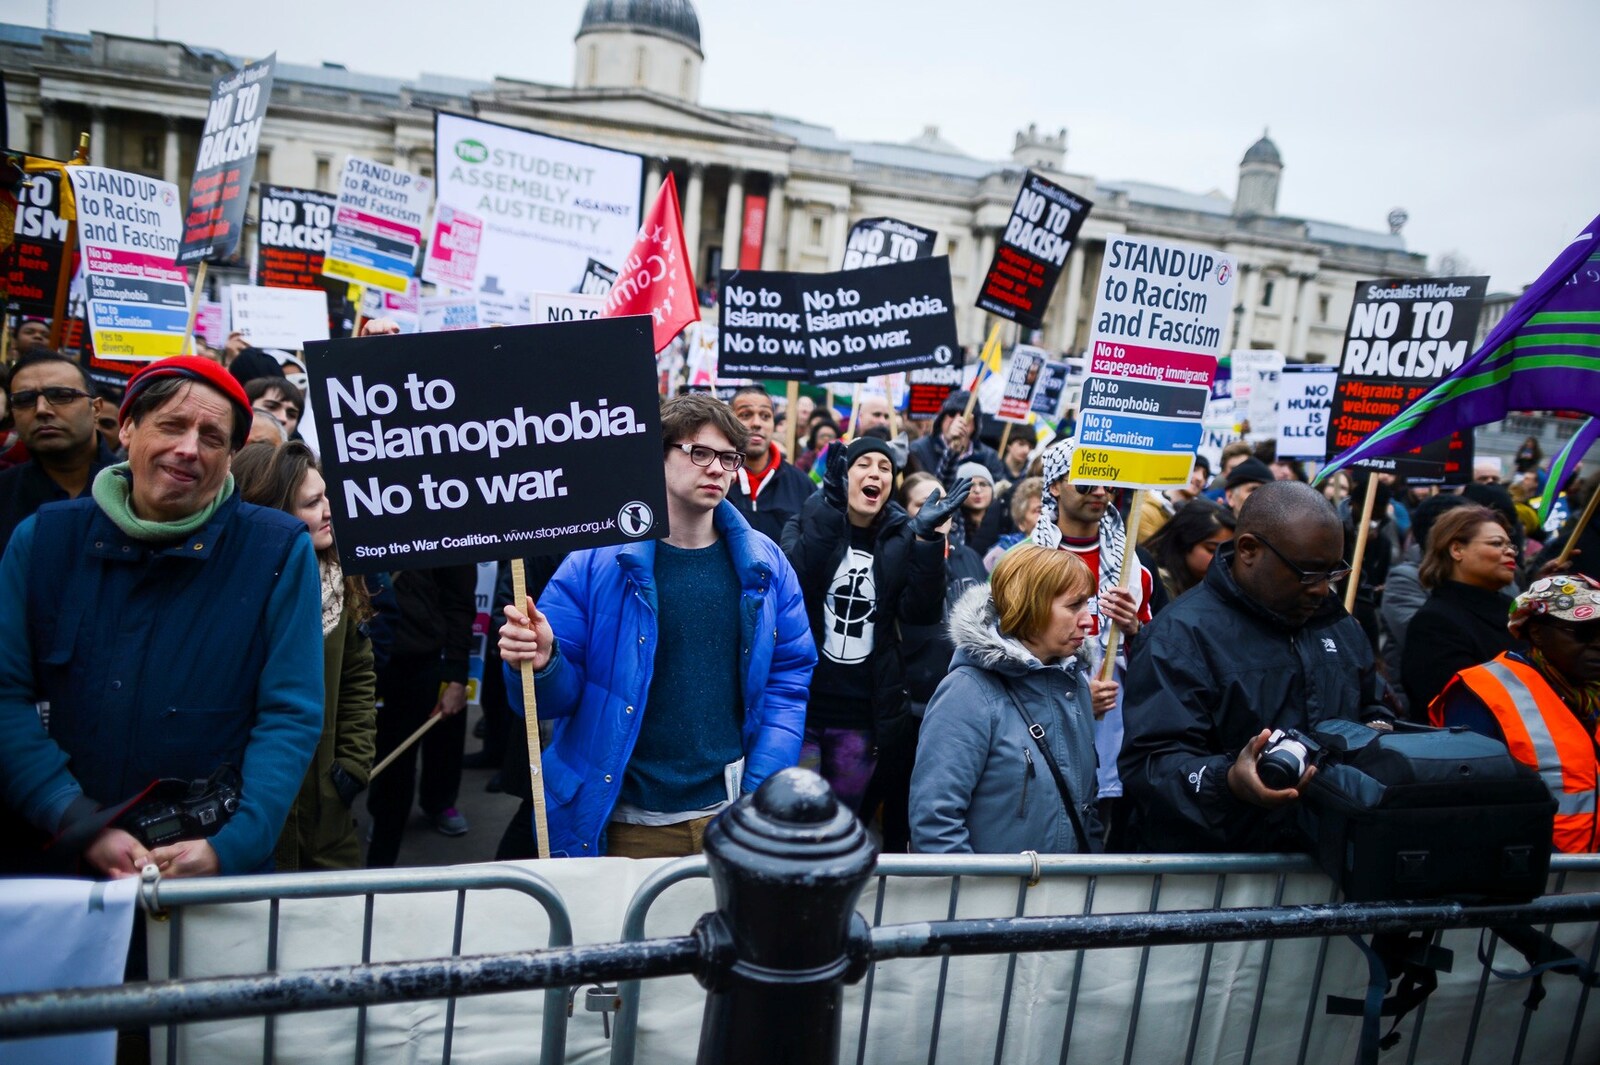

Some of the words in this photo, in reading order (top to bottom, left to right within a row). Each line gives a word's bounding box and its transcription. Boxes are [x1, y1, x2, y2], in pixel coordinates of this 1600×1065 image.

[205, 94, 232, 135] NO
[234, 82, 260, 124] TO
[196, 116, 262, 172] RACISM
[348, 160, 390, 182] STAND
[393, 173, 411, 186] UP
[493, 149, 595, 185] STUDENT
[76, 170, 136, 198] STAND
[138, 180, 156, 202] UP
[345, 176, 358, 189] to
[362, 180, 408, 203] Racism
[450, 166, 570, 202] ASSEMBLY
[574, 198, 631, 215] AGAINST
[81, 195, 99, 215] to
[104, 197, 160, 227] Racism
[262, 197, 296, 223] NO
[302, 202, 330, 228] TO
[342, 192, 366, 208] and
[370, 200, 420, 223] Fascism
[478, 196, 600, 234] AUSTERITY
[1015, 188, 1046, 222] NO
[1044, 202, 1071, 235] TO
[84, 222, 117, 242] and
[122, 225, 180, 252] Fascism
[848, 227, 884, 254] NO
[890, 233, 918, 262] TO
[1004, 215, 1071, 266] RACISM
[88, 248, 100, 258] No
[102, 250, 112, 260] to
[1109, 240, 1186, 277] STAND
[1188, 253, 1214, 282] UP
[92, 276, 104, 286] No
[106, 278, 115, 287] to
[1104, 275, 1128, 302] to
[1132, 278, 1208, 314] Racism
[1368, 283, 1422, 300] Socialist
[1423, 283, 1470, 298] Worker
[95, 304, 107, 314] No
[109, 306, 118, 315] to
[726, 286, 756, 306] No
[759, 288, 782, 307] to
[803, 290, 835, 311] No
[836, 288, 860, 306] to
[548, 306, 572, 322] NO
[725, 307, 801, 333] Islamop
[806, 295, 948, 332] Islamophobia.
[1350, 302, 1400, 338] NO
[1412, 301, 1454, 339] TO
[1098, 309, 1143, 337] and
[1148, 313, 1220, 348] Fascism
[724, 333, 754, 352] No
[757, 335, 780, 354] to
[810, 338, 840, 358] No
[843, 334, 866, 353] to
[868, 330, 911, 350] war.
[1096, 342, 1111, 358] No
[1114, 346, 1126, 359] to
[1094, 358, 1164, 380] scapegoating
[1166, 365, 1209, 384] immigrants
[1342, 340, 1468, 378] RACISM
[326, 376, 398, 418] No
[404, 373, 456, 411] to
[1091, 378, 1106, 393] No
[1107, 381, 1118, 394] to
[1306, 385, 1328, 396] NO
[1346, 382, 1404, 399] Migrants
[1408, 387, 1428, 400] ar
[1088, 392, 1160, 413] islamophobia
[1288, 399, 1332, 410] HUMA
[1343, 399, 1399, 416] welcome
[333, 398, 646, 463] Islamophobia.
[1085, 412, 1100, 428] No
[1102, 415, 1112, 428] to
[1309, 412, 1322, 424] IS
[1084, 430, 1102, 442] anti
[1104, 430, 1154, 447] Semitism
[1284, 426, 1325, 437] ILLEG
[1336, 432, 1364, 447] Isla
[1080, 450, 1096, 462] Yes
[1098, 452, 1108, 463] to
[1078, 463, 1120, 480] diversity
[342, 476, 412, 518] No
[418, 474, 469, 510] to
[476, 467, 568, 505] war.
[355, 544, 386, 558] Stop
[388, 542, 410, 554] the
[412, 539, 438, 552] War
[441, 534, 501, 549] Coalition.
[503, 518, 615, 542] www.stopwar.org.uk
